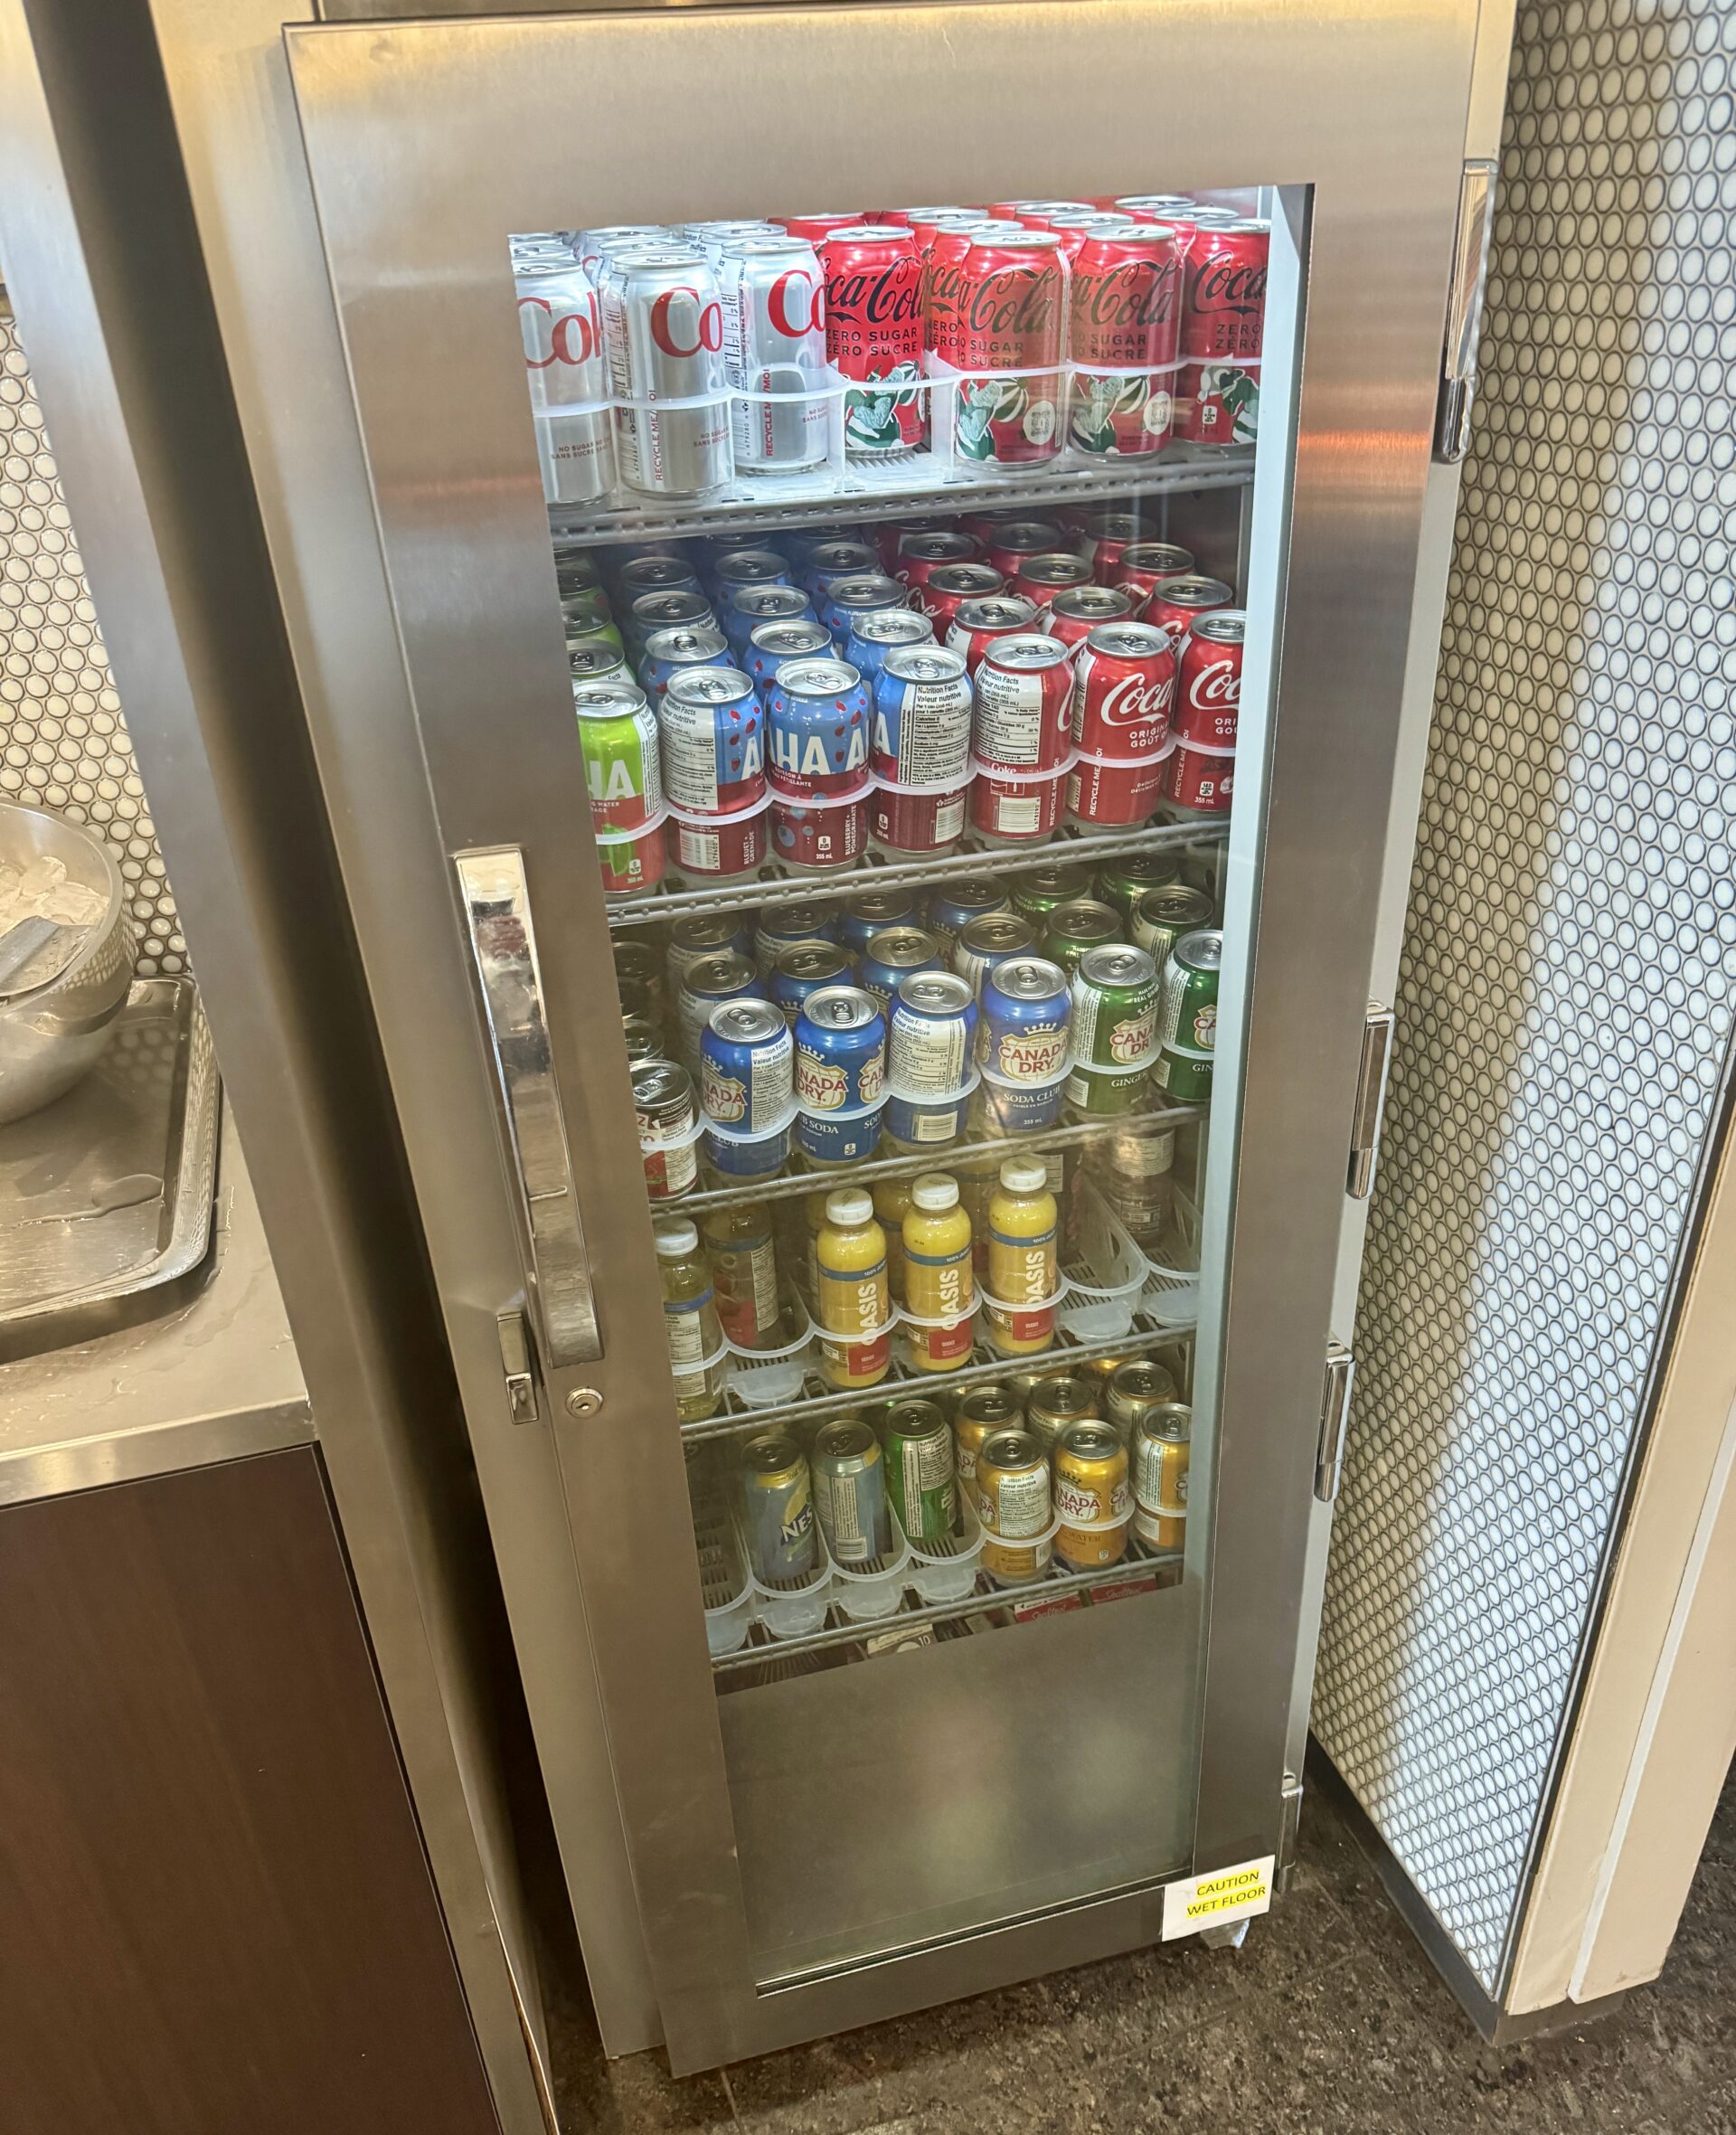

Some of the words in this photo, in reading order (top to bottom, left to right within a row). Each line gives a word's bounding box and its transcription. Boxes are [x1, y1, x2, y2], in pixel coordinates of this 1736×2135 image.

[826, 330, 862, 343] ZERO
[869, 326, 918, 343] SUGAR
[1216, 324, 1260, 335] ZERO
[970, 339, 1024, 353] SUGAR
[1090, 334, 1146, 345] SUGAR
[1215, 336, 1260, 350] ZÉRO
[871, 342, 918, 357] SUCRE
[1090, 349, 1146, 360] SUCRE
[970, 354, 1024, 368] SUCRE
[764, 411, 774, 457] RECYCLE
[651, 435, 663, 481] RECYCLE
[1003, 676, 1019, 685] Facts
[994, 683, 1020, 694] nutritive
[1130, 734, 1159, 748] GOÛT
[1175, 764, 1184, 798] RECYCLE
[1090, 780, 1099, 816] RECYCLE
[1049, 790, 1057, 827] RECYCLE
[1004, 1093, 1034, 1103] SODA
[809, 1120, 839, 1134] SODA
[919, 1635, 931, 1648] 10
[1196, 1871, 1260, 1896] CAUTION
[1186, 1900, 1218, 1916] WET
[1222, 1885, 1266, 1907] FLOOR
